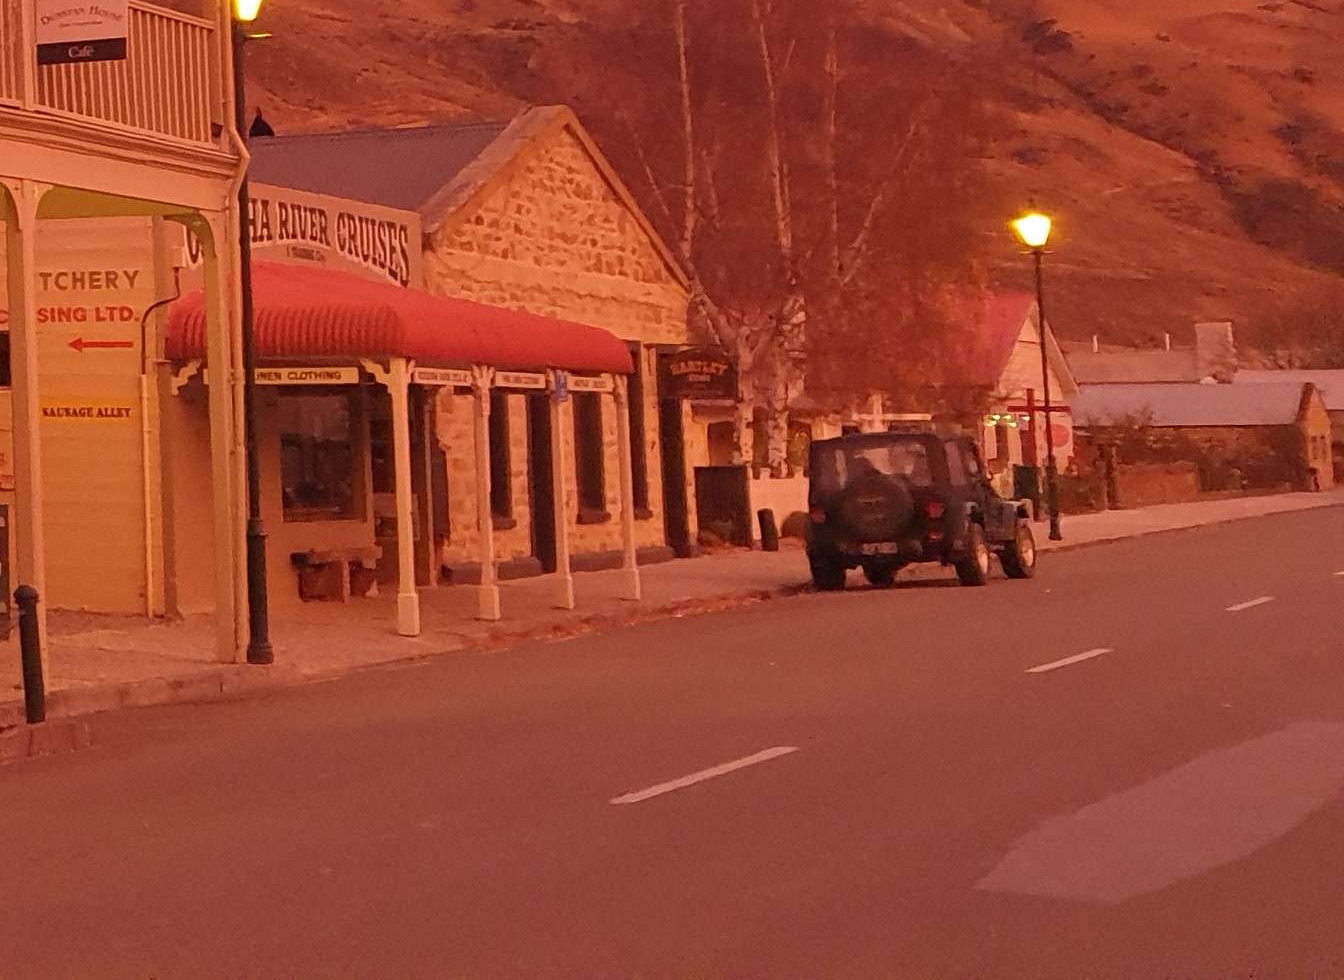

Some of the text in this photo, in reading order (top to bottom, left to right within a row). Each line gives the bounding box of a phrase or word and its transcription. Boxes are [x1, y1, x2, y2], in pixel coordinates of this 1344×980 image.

[277, 202, 331, 247] RIVER
[335, 211, 411, 289] CRUISES
[39, 269, 141, 292] TCHERY
[36, 305, 141, 324] SING LTD.
[287, 370, 342, 381] CLOTHING
[42, 406, 132, 418] SAUSAGE ALLEY
